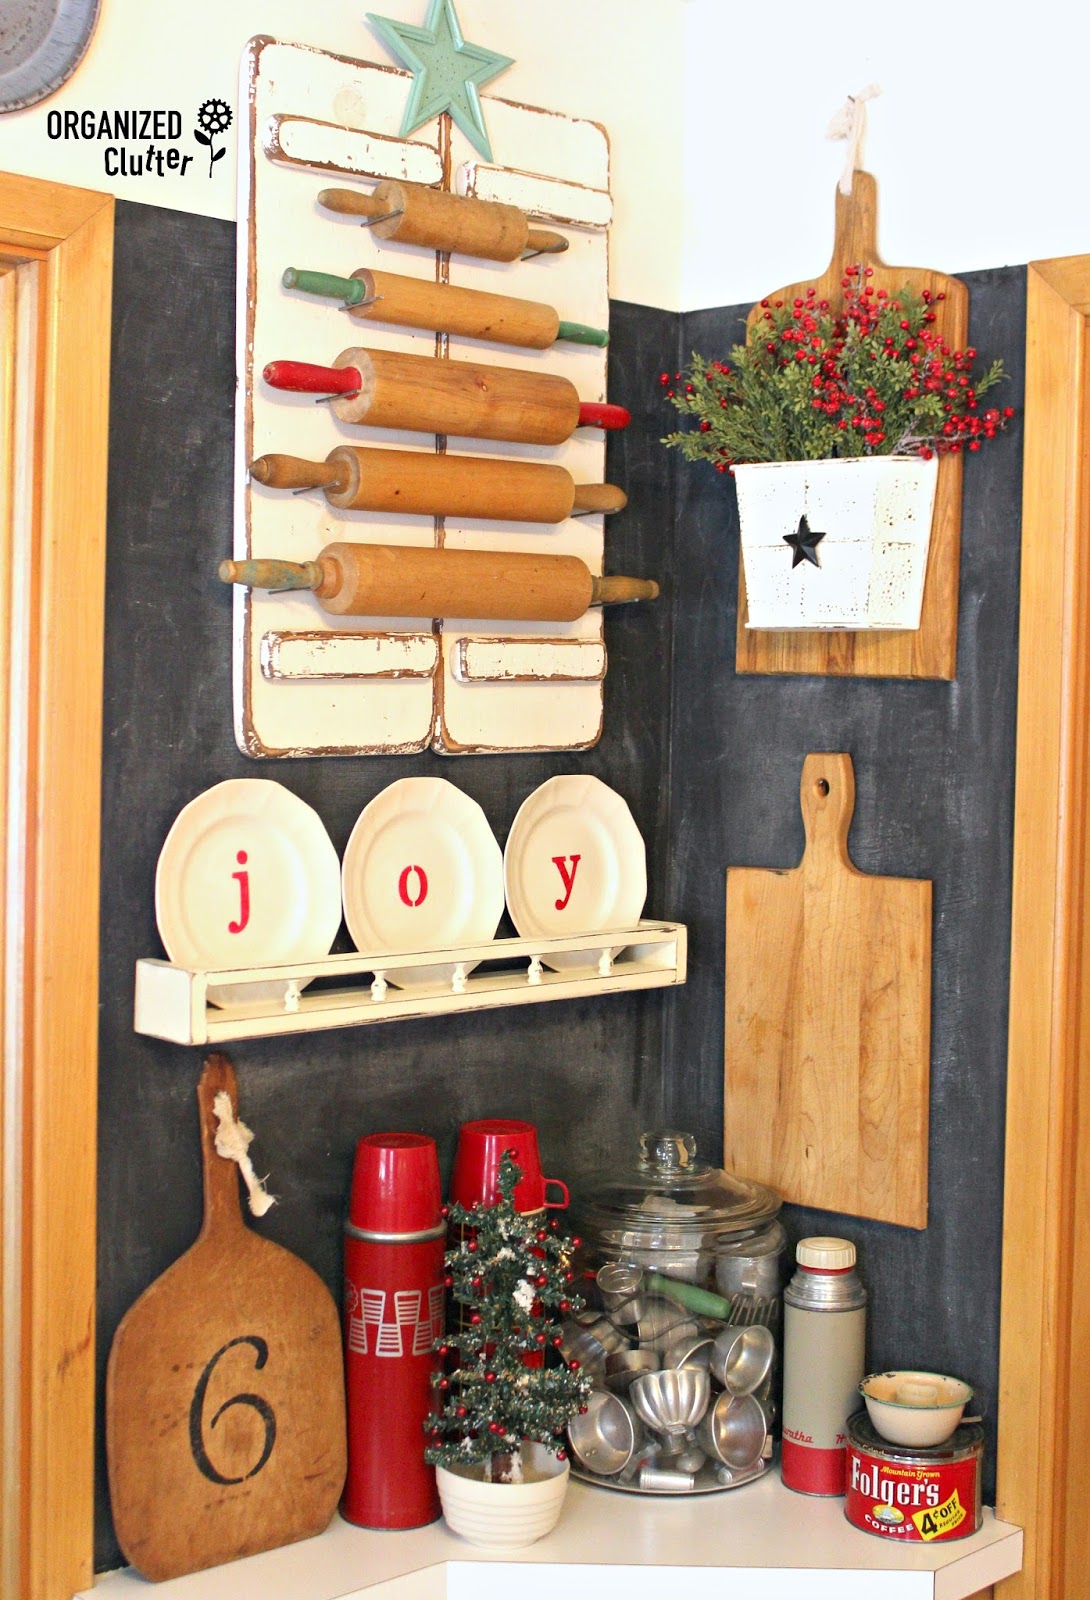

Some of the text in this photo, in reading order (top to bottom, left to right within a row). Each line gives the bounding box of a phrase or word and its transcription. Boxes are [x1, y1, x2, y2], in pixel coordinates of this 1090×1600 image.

[189, 1335, 276, 1486] 6
[851, 1454, 939, 1507] Folger's
[880, 1465, 941, 1481] Mountain Grown
[940, 1497, 957, 1518] OFF
[864, 1513, 914, 1533] COFFEE
